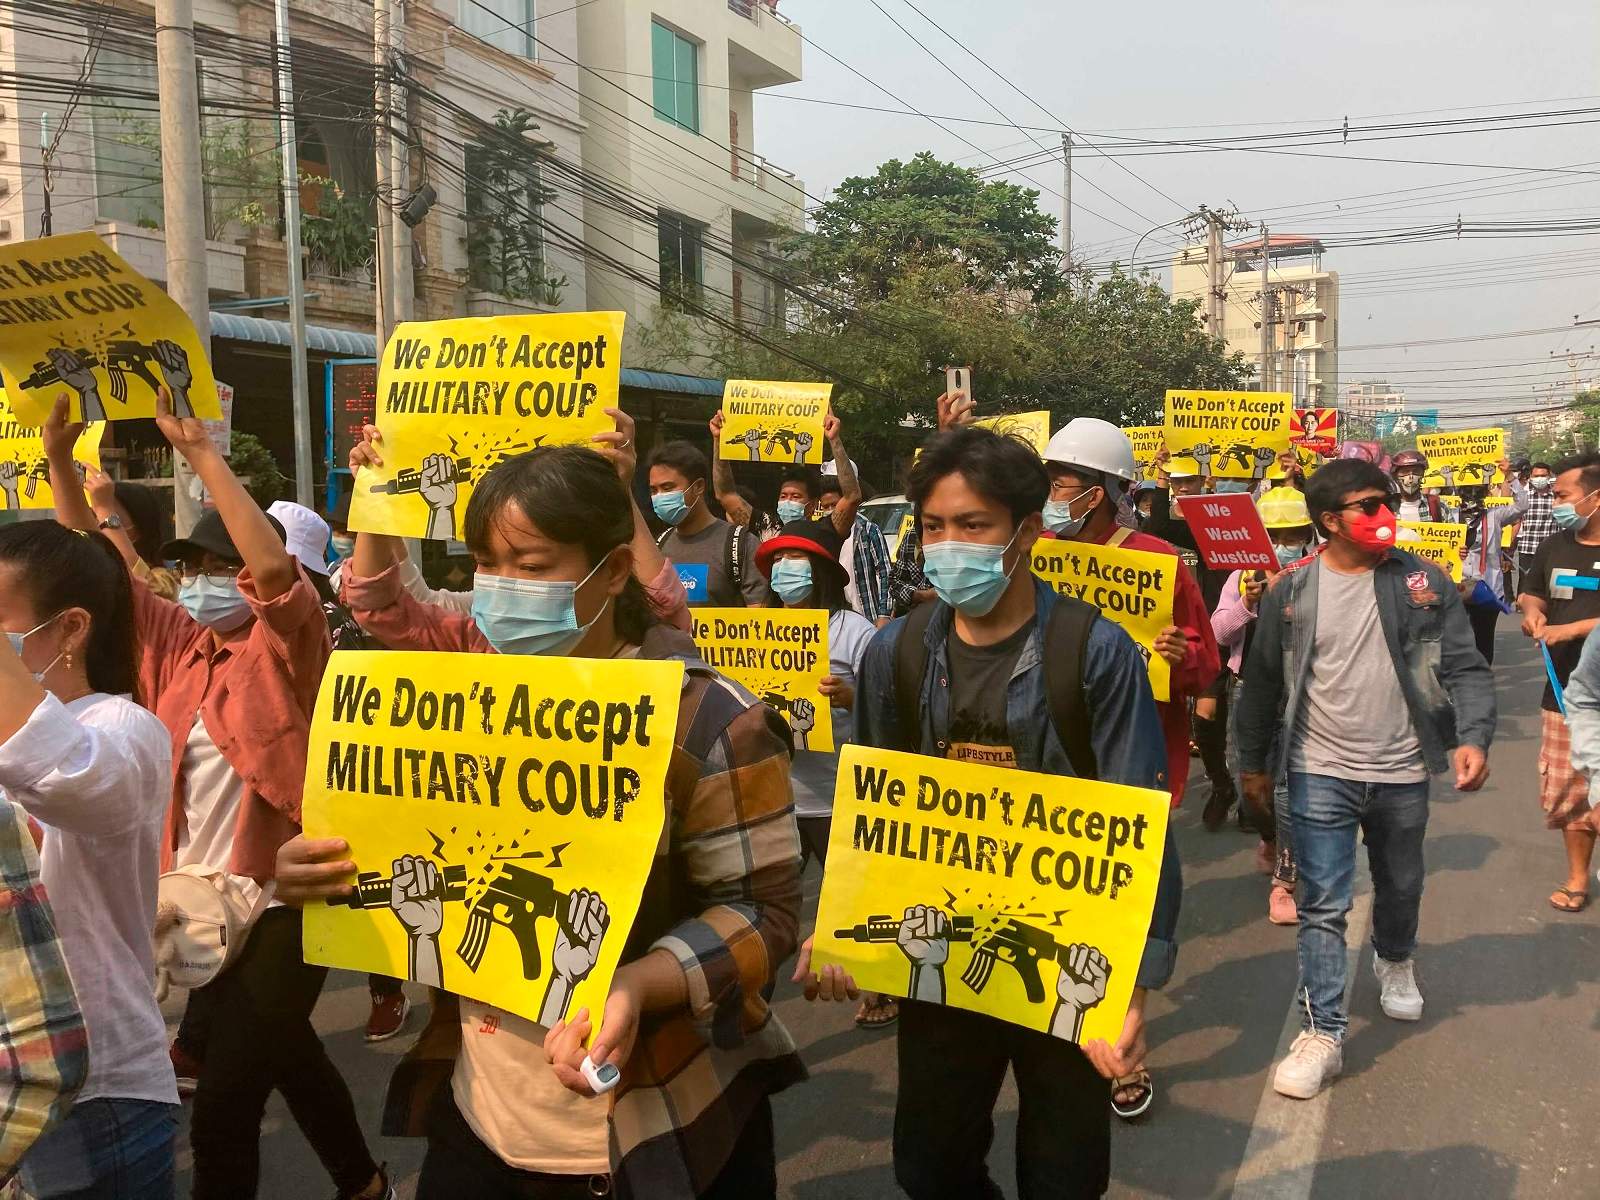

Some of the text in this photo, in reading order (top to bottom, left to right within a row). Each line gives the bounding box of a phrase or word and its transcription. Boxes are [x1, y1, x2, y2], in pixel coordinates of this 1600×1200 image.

[17, 250, 122, 285] Accept
[0, 283, 146, 325] ITARY COUP
[393, 334, 607, 380] We Don't Accept
[386, 380, 508, 416] MILITARY
[514, 380, 597, 418] COUP
[730, 384, 748, 398] We
[729, 402, 820, 417] MILITARY COUP
[1172, 396, 1285, 418] We Don't Accept
[1173, 415, 1280, 432] MILITARY COUP
[1132, 431, 1156, 440] Don't
[1421, 434, 1498, 448] We Don't Accept
[1133, 442, 1158, 451] ITARY
[1424, 444, 1497, 458] MILITARY COUP
[1202, 503, 1231, 517] We
[1204, 526, 1251, 541] Want
[1426, 527, 1461, 539] Accept
[1209, 550, 1270, 564] Justice
[1407, 546, 1444, 559] Accept
[1033, 552, 1081, 576] on't
[1086, 557, 1164, 595] Accept
[1094, 587, 1157, 618] COUP
[714, 619, 761, 640] Don't
[764, 620, 820, 649] Accept
[698, 646, 817, 672] ILITARY COUP
[332, 674, 655, 761] We Don't Accept
[957, 747, 1013, 762] LIFESTYLE
[326, 741, 642, 822] MILITARY COUP
[853, 764, 1149, 856] We Don't Accept
[853, 814, 1135, 900] MILITARY COUP
